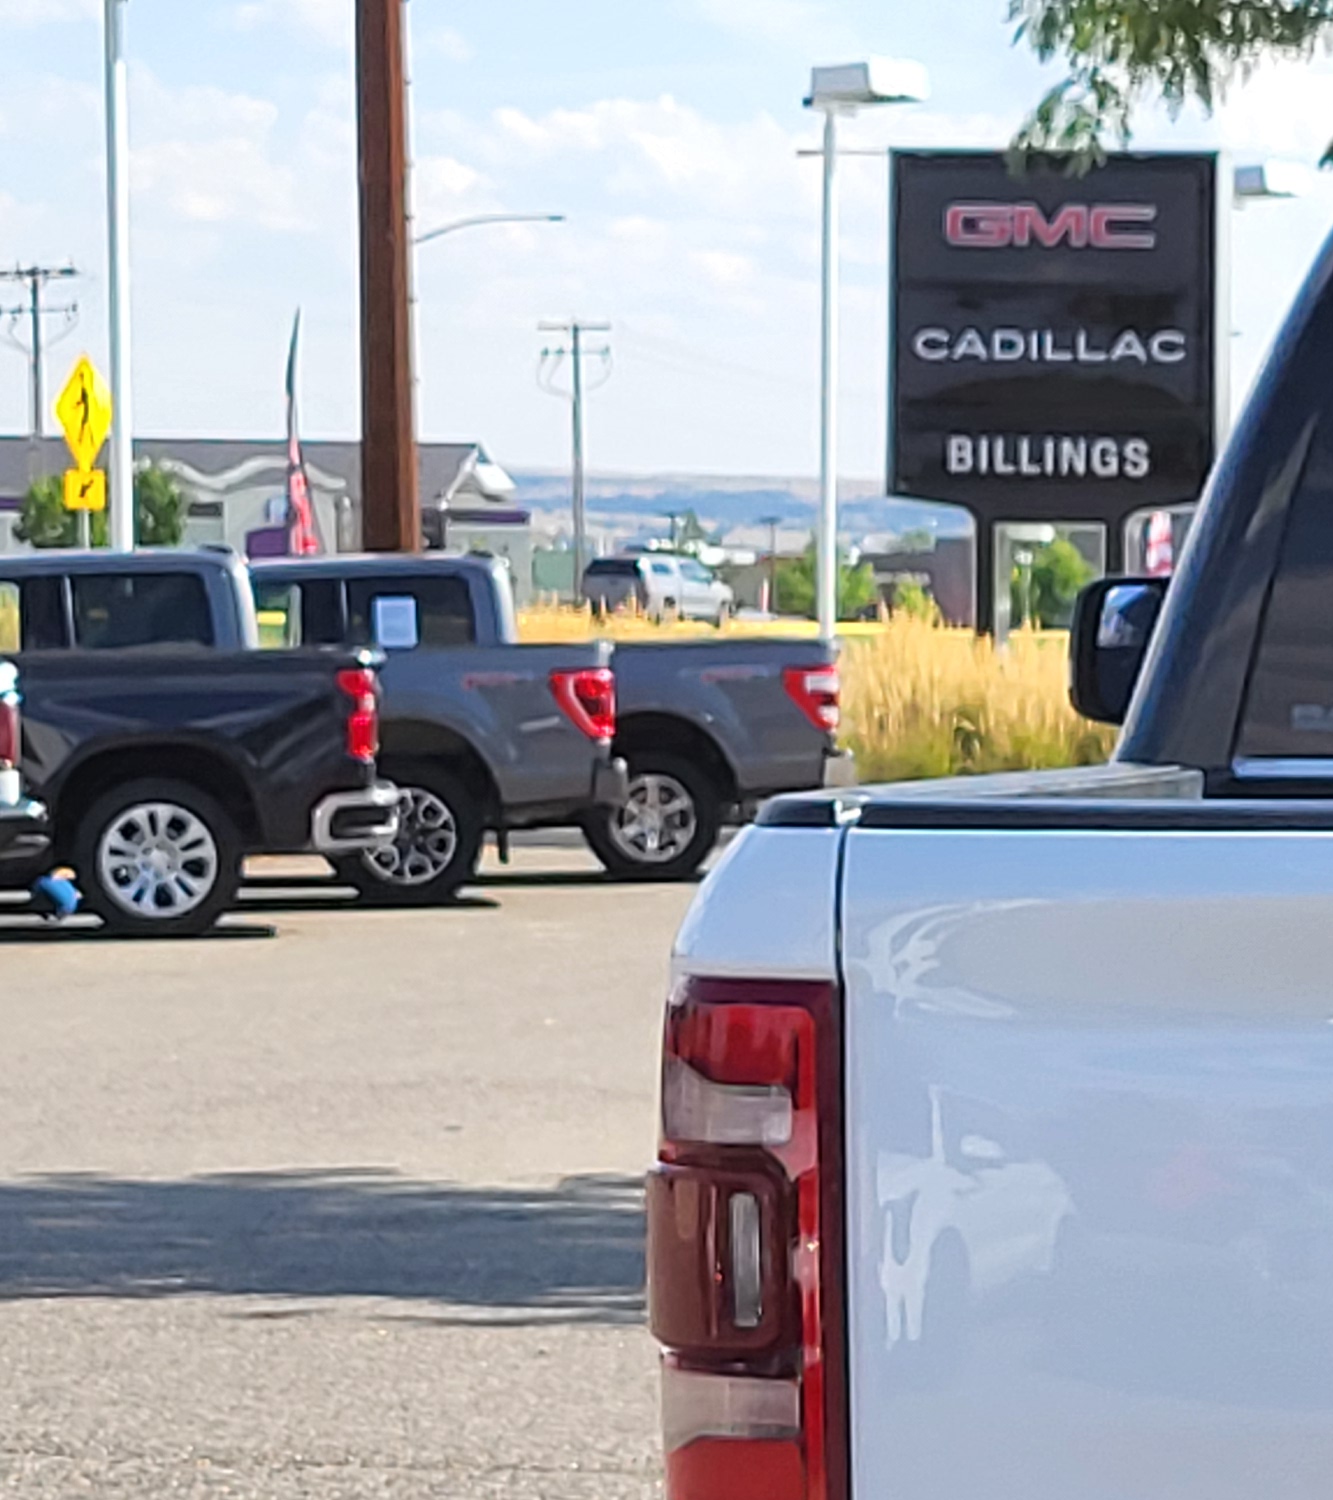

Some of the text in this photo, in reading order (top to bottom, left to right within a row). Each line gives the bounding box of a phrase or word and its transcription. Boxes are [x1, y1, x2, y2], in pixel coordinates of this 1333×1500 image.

[945, 204, 1157, 248] GMC
[914, 328, 1187, 364] CADILLAC
[946, 434, 1150, 477] BILLINGS
